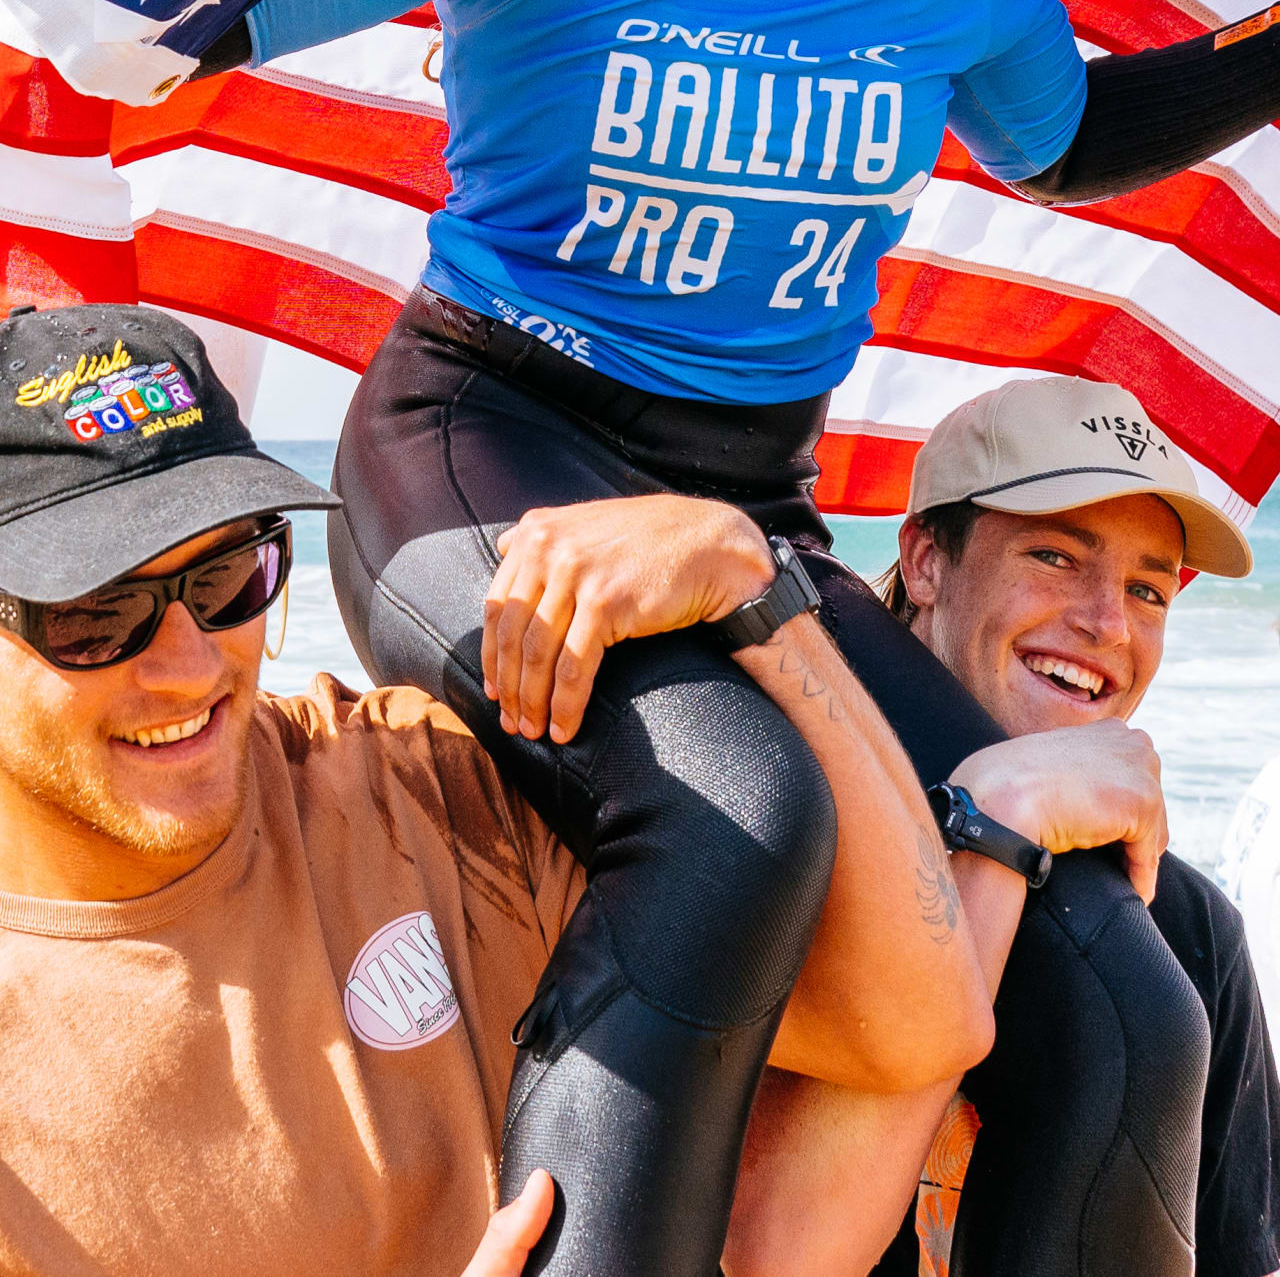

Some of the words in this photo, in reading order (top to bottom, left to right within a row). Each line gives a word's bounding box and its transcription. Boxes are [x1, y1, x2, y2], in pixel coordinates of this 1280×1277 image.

[616, 19, 821, 63] O'NEILL
[591, 51, 903, 184] BALLITO
[556, 184, 735, 295] PRO
[769, 218, 867, 309] 24
[491, 296, 521, 321] WSL
[15, 339, 132, 407] English
[75, 384, 191, 438] COLOR
[141, 416, 168, 438] and
[166, 406, 203, 428] supply
[1080, 416, 1168, 460] VISSLA
[417, 1006, 445, 1035] Since
